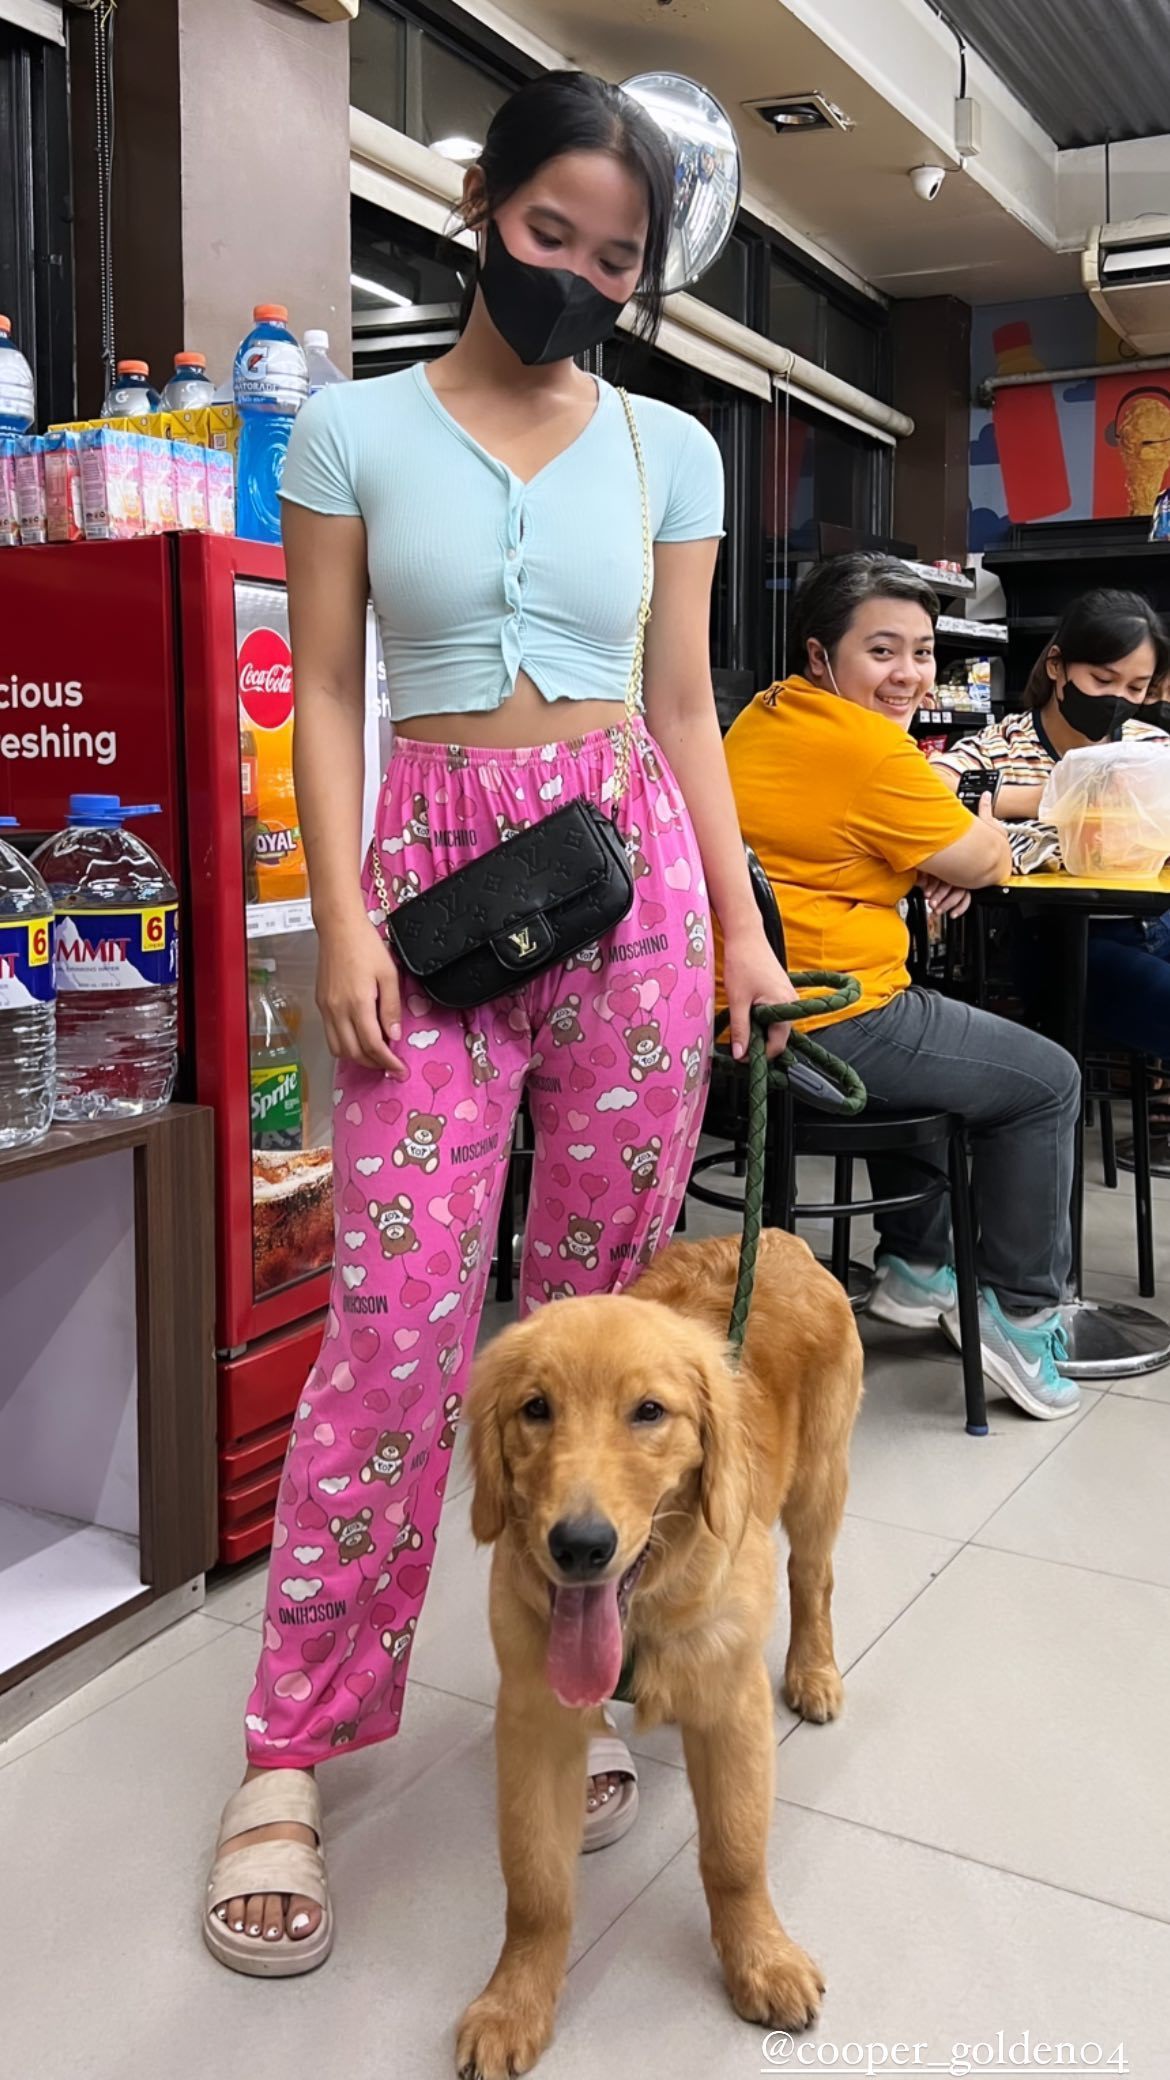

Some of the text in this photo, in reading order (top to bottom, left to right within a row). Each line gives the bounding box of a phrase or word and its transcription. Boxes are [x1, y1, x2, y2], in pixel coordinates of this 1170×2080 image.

[115, 391, 128, 403] G
[0, 723, 117, 766] eshing
[33, 928, 46, 956] 6
[147, 916, 163, 942] 6
[507, 926, 539, 958] LV
[607, 934, 670, 964] MOSCHINO
[251, 1072, 298, 1120] Sprite
[450, 1132, 500, 1166] MOSCHINO
[278, 1600, 347, 1626] MOSCHINO
